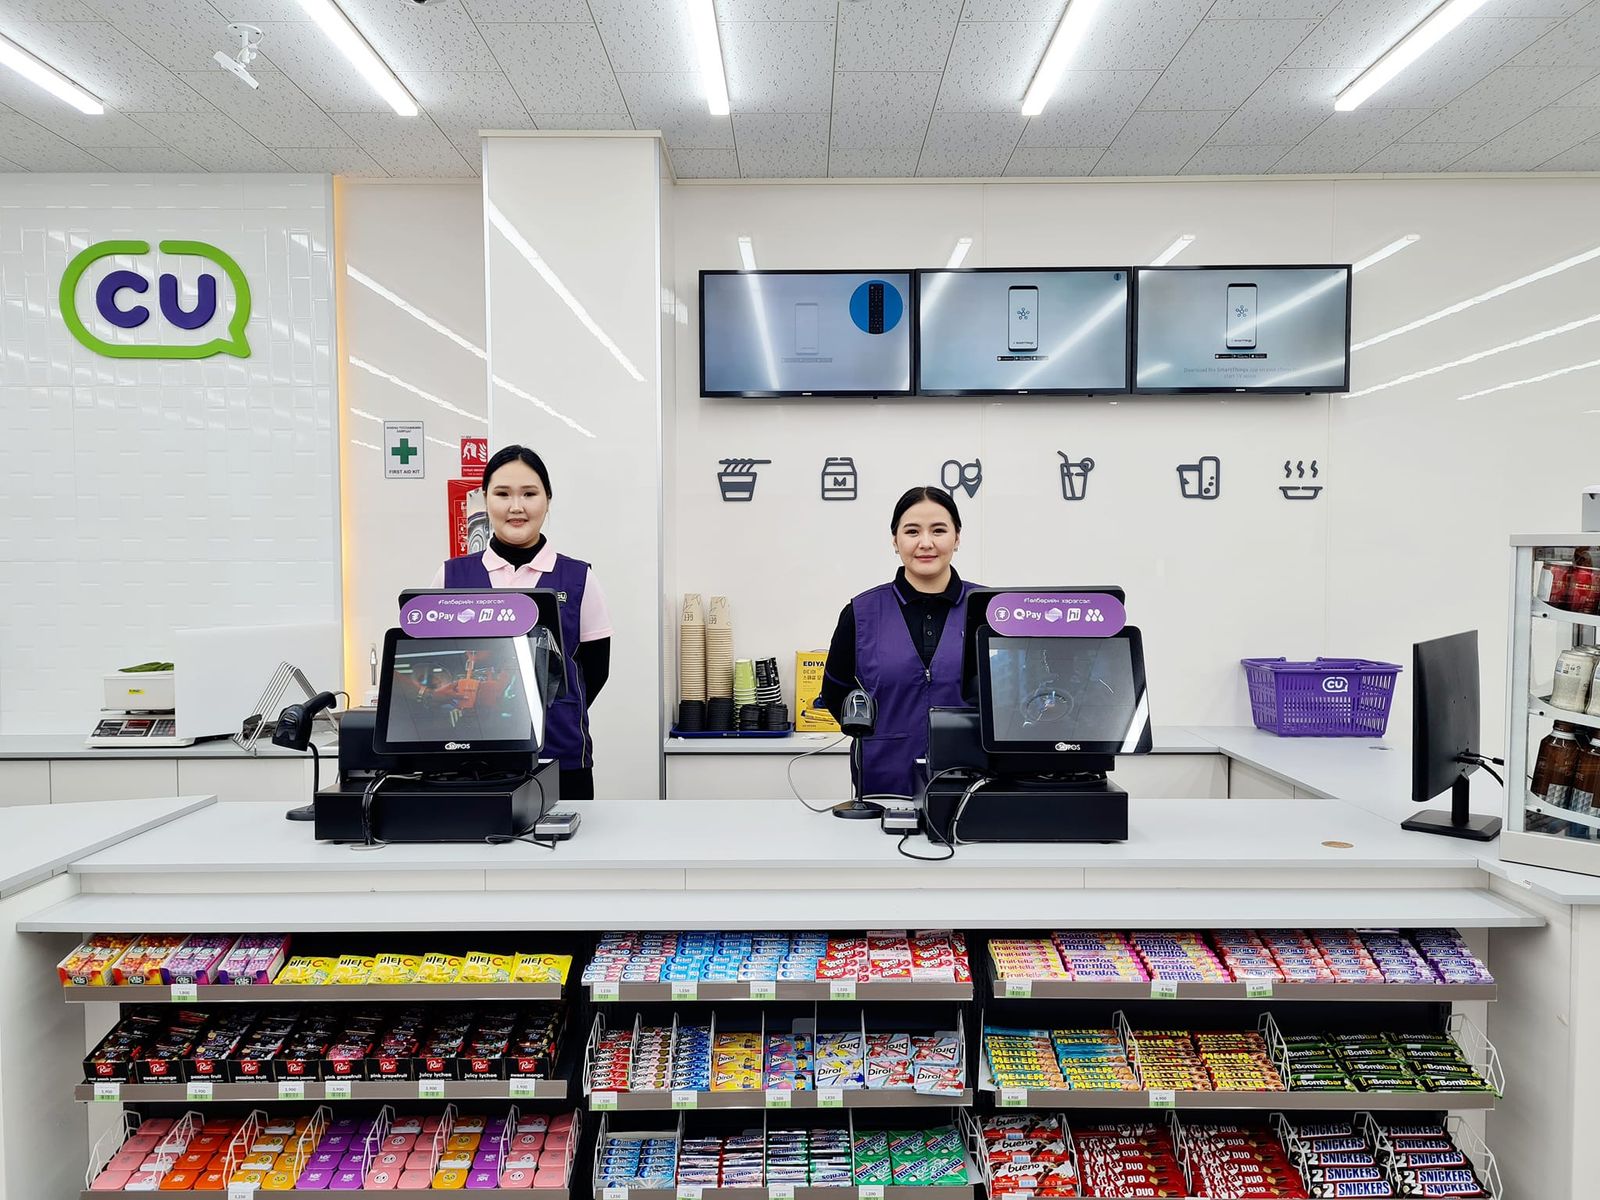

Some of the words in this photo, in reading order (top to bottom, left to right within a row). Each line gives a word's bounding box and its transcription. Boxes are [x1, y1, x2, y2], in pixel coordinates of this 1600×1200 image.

[96, 269, 217, 330] CU
[426, 610, 454, 622] QPay
[482, 609, 492, 618] hi
[1013, 608, 1042, 621] QPay
[1069, 609, 1079, 619] hi
[1326, 680, 1343, 690] CU
[818, 1068, 842, 1076] Dirol
[868, 1068, 892, 1076] Dirol
[1066, 1066, 1113, 1074] MELLER
[996, 1117, 1027, 1127] bueno
[1301, 1124, 1351, 1137] SNICKERS
[1392, 1126, 1441, 1135] SNICKERS
[855, 1132, 887, 1153] mentos
[891, 1132, 924, 1153] mentos
[928, 1130, 959, 1152] mentos
[1002, 1140, 1034, 1148] bueno
[1301, 1141, 1311, 1153] 2
[1315, 1140, 1364, 1151] SNICKERS
[1396, 1140, 1448, 1149] SNICKERS
[1307, 1153, 1318, 1165] 2
[1323, 1153, 1373, 1164] SNICKERS
[1396, 1156, 1407, 1168] 2
[1411, 1152, 1462, 1165] SNICKERS
[857, 1158, 890, 1179] mentos
[895, 1158, 928, 1179] mentos
[931, 1158, 962, 1180] mentos
[1008, 1163, 1040, 1173] bueno
[1240, 1164, 1259, 1172] DUO
[1127, 1175, 1145, 1183] DUO
[1245, 1175, 1263, 1183] DUO
[1312, 1169, 1323, 1182] 2
[1327, 1168, 1379, 1180] SNICKERS
[1404, 1171, 1416, 1183] 2
[1420, 1170, 1472, 1182] SNICKERS
[1136, 1188, 1154, 1196] DUO
[1323, 1183, 1335, 1198] 2
[1338, 1182, 1390, 1196] SNICKERS
[1412, 1184, 1423, 1195] 2
[1427, 1182, 1478, 1195] SNICKERS
